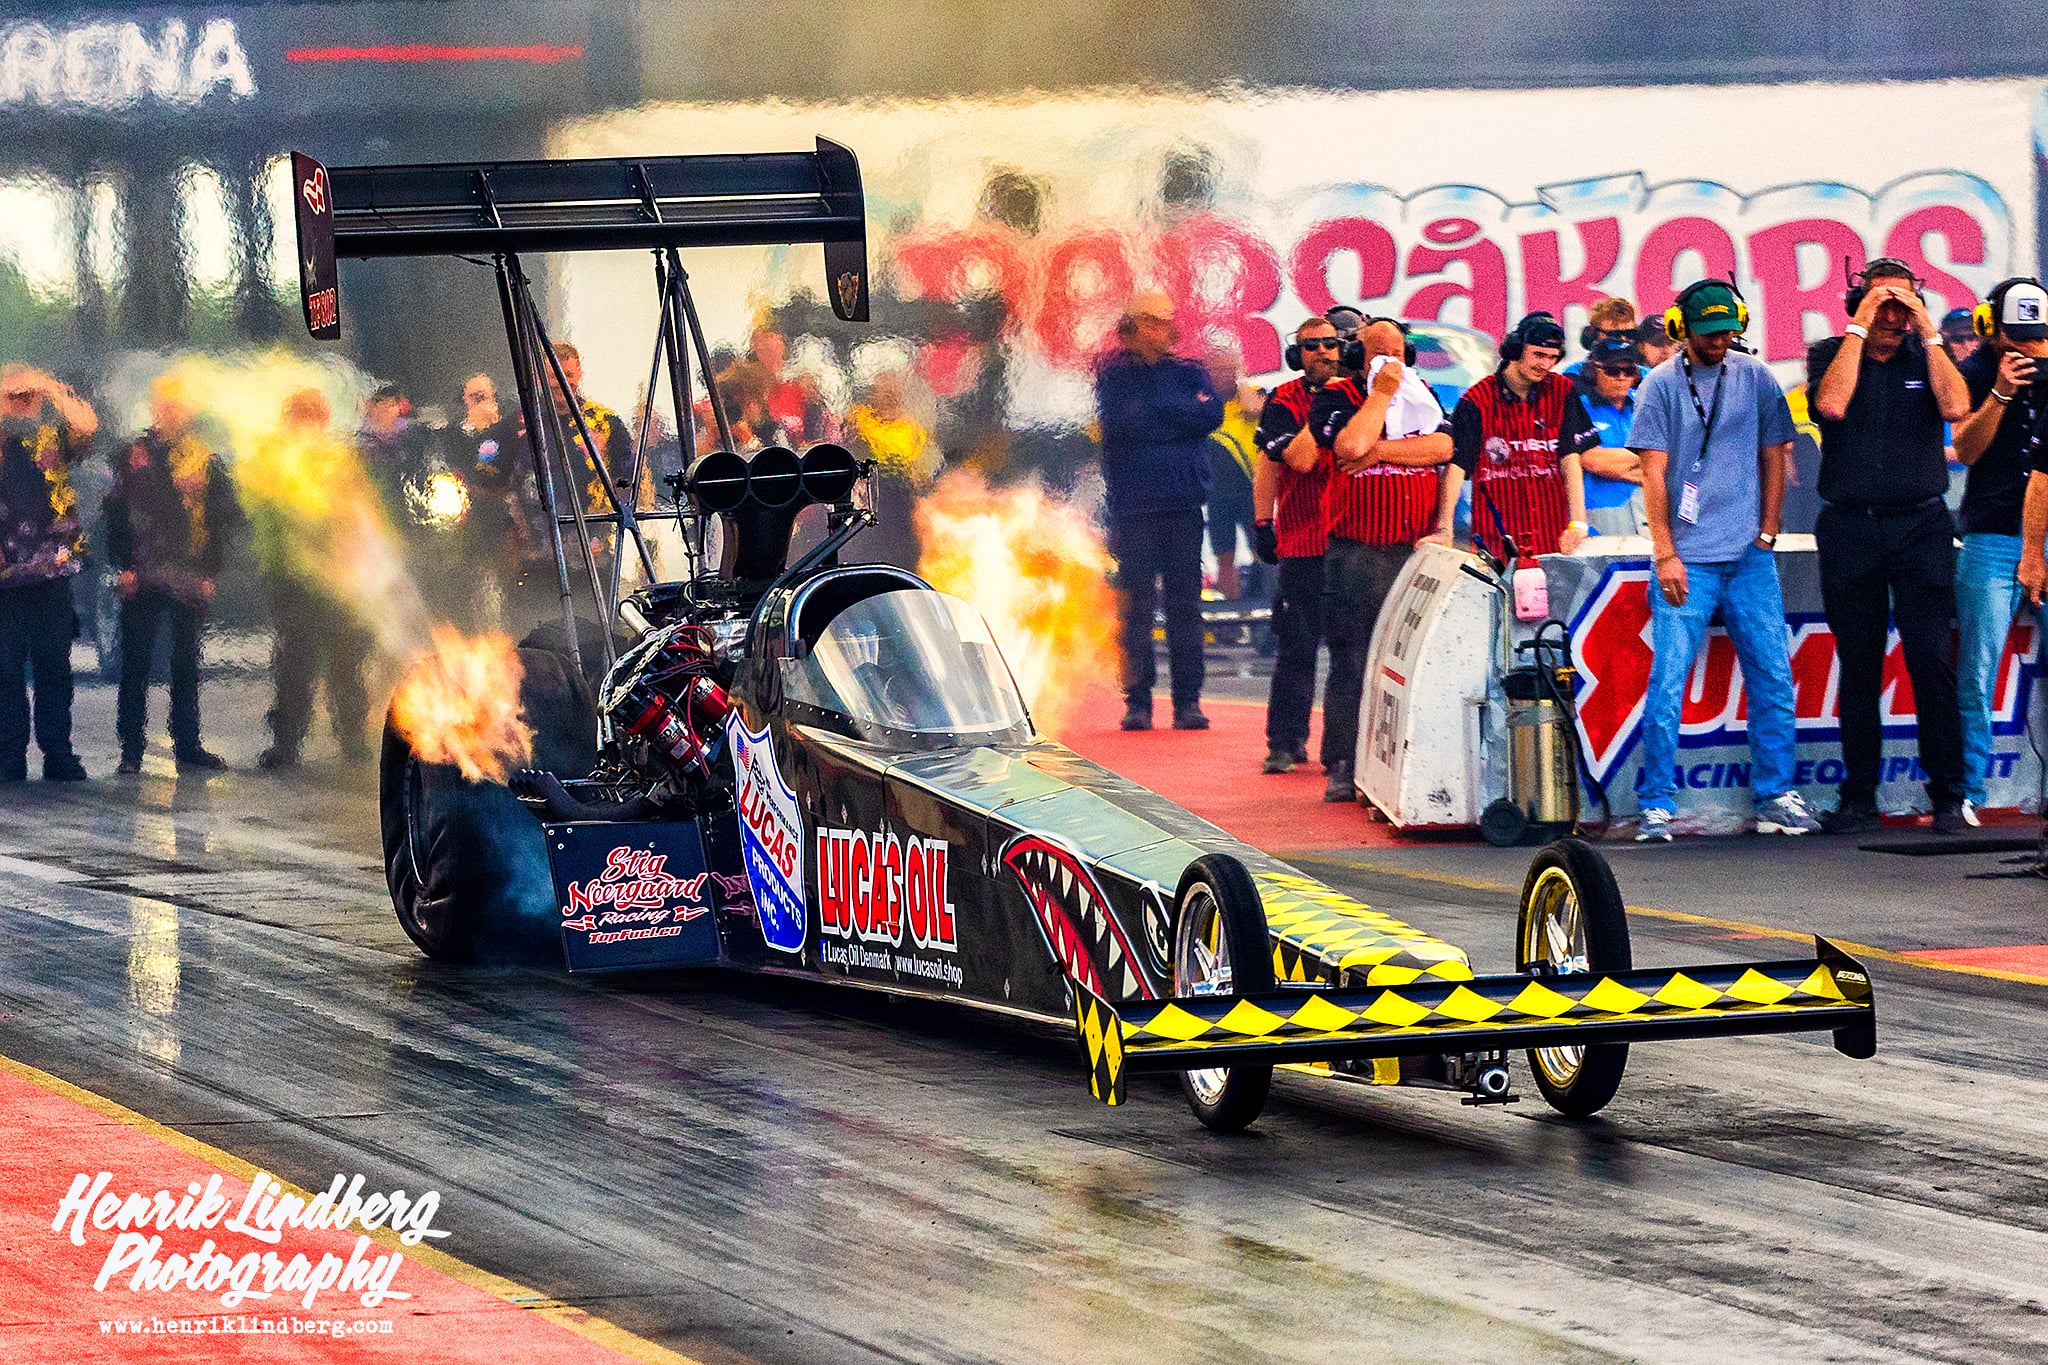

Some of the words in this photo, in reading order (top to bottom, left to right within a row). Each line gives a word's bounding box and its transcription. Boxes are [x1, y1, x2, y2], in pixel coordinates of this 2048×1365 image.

[1635, 761, 1753, 791] ACIN
[1791, 752, 2021, 787] EQIPMT
[740, 778, 798, 879] LUCAS
[601, 846, 676, 883] Stig
[562, 872, 709, 917] Neergaard
[752, 845, 802, 931] PRODUCTS
[760, 887, 780, 932] INC.
[817, 827, 904, 949] LUCAS
[905, 834, 958, 953] OIL
[588, 925, 683, 945] TopFuel.eu
[598, 907, 671, 927] Racing
[827, 940, 849, 965] Lucas
[848, 943, 860, 966] Oil
[860, 945, 893, 971] Denmark
[894, 953, 963, 989] www.lucasoil.shop
